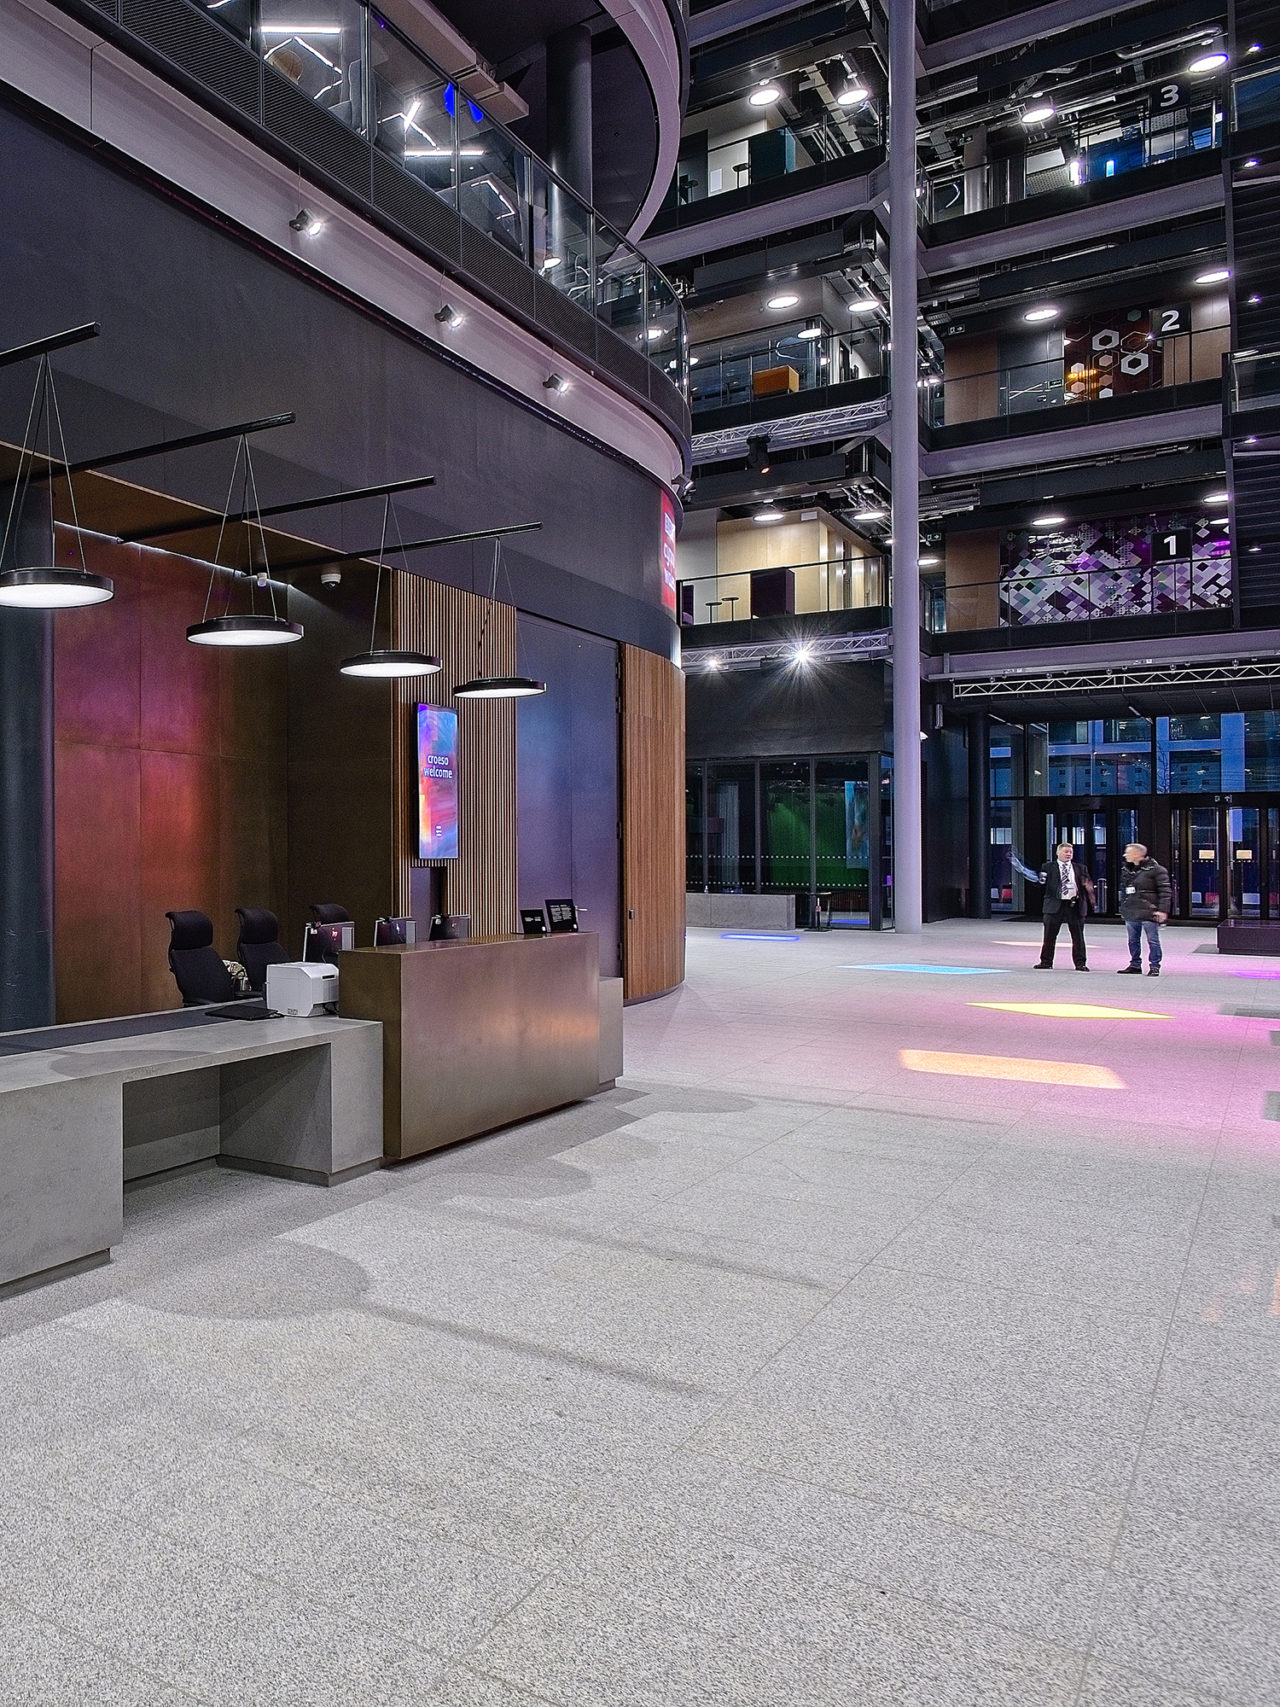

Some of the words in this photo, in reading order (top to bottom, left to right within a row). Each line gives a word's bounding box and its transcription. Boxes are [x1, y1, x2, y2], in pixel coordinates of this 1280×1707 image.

[1160, 84, 1179, 107] 3
[1161, 310, 1180, 331] 2
[1163, 535, 1176, 556] 1
[427, 755, 449, 766] croeso
[423, 765, 453, 779] welcome
